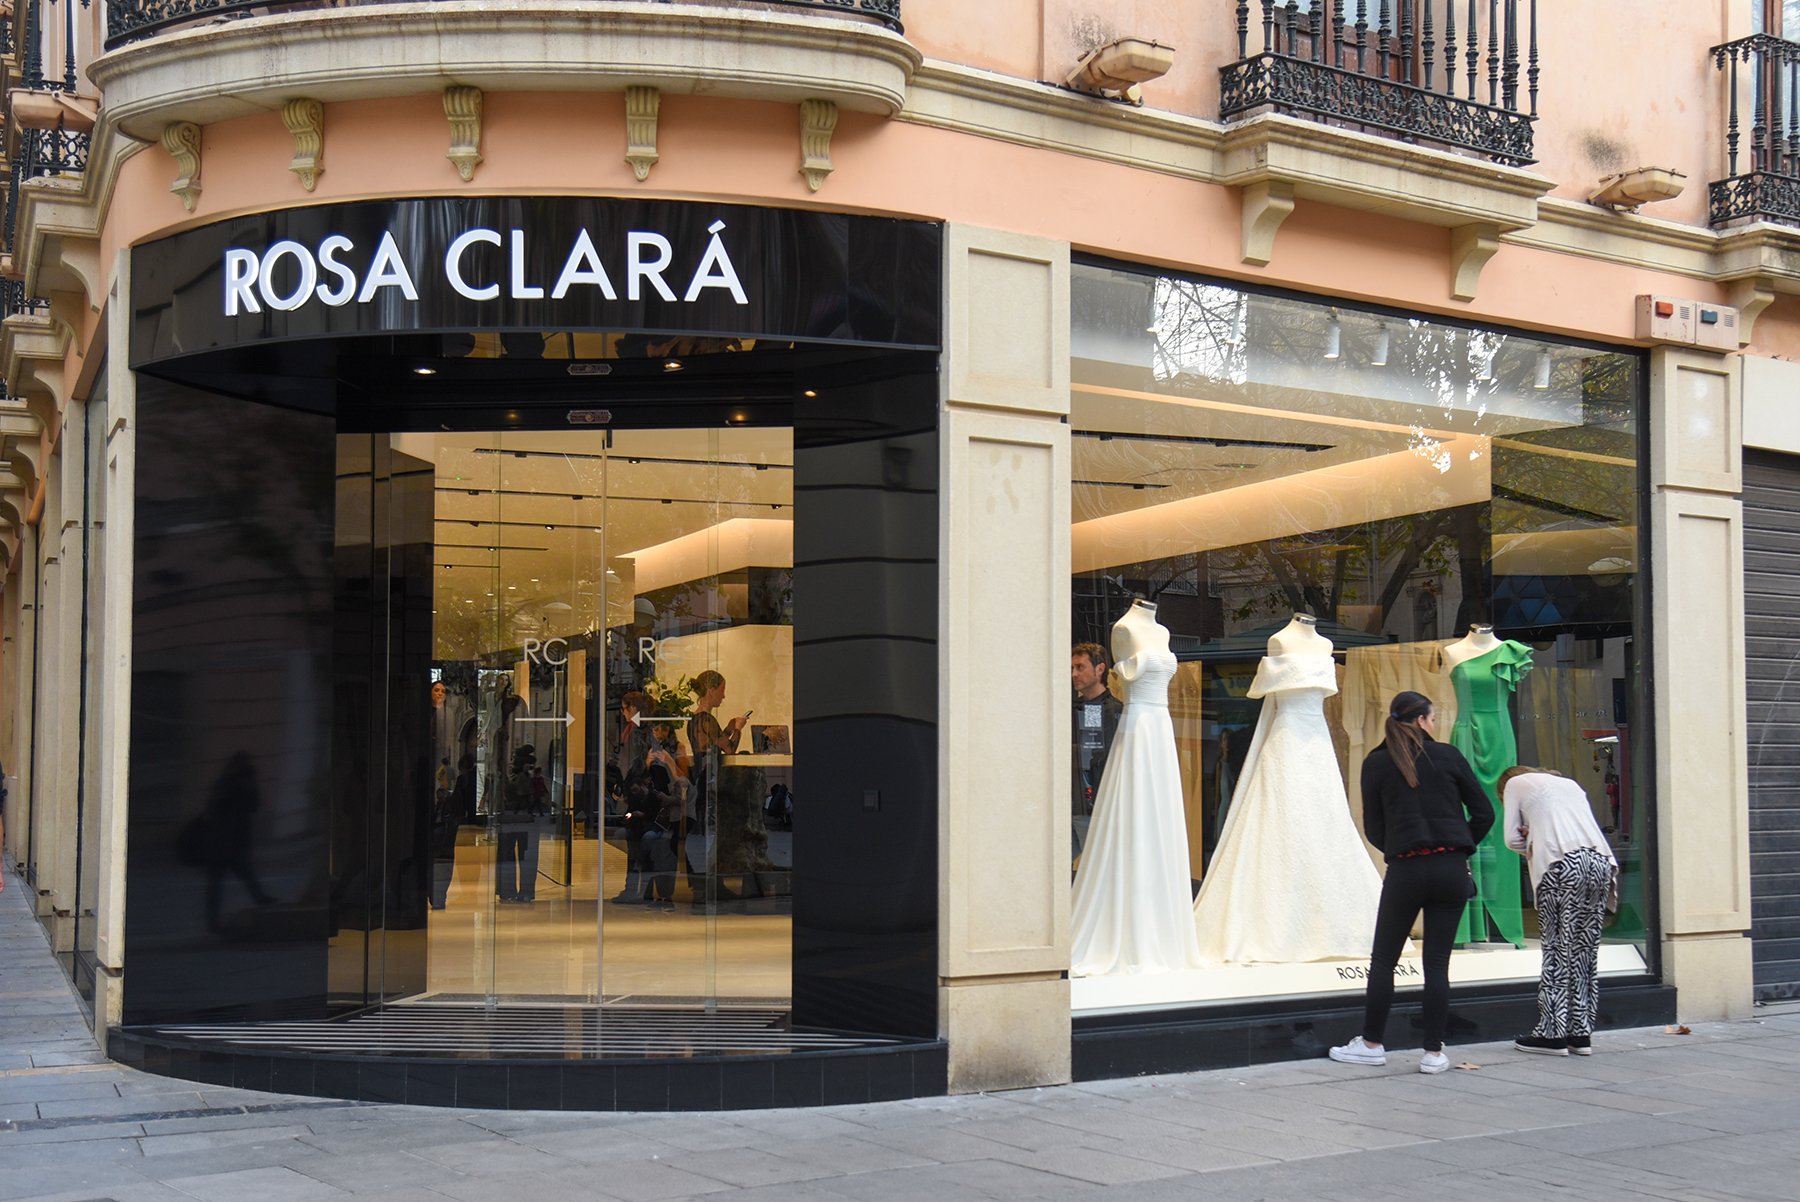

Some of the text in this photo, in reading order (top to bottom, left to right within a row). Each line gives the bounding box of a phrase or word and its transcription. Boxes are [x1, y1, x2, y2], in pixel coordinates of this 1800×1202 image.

[224, 219, 749, 317] ROSA CLARÁ
[523, 637, 568, 665] RC
[638, 636, 683, 664] RC
